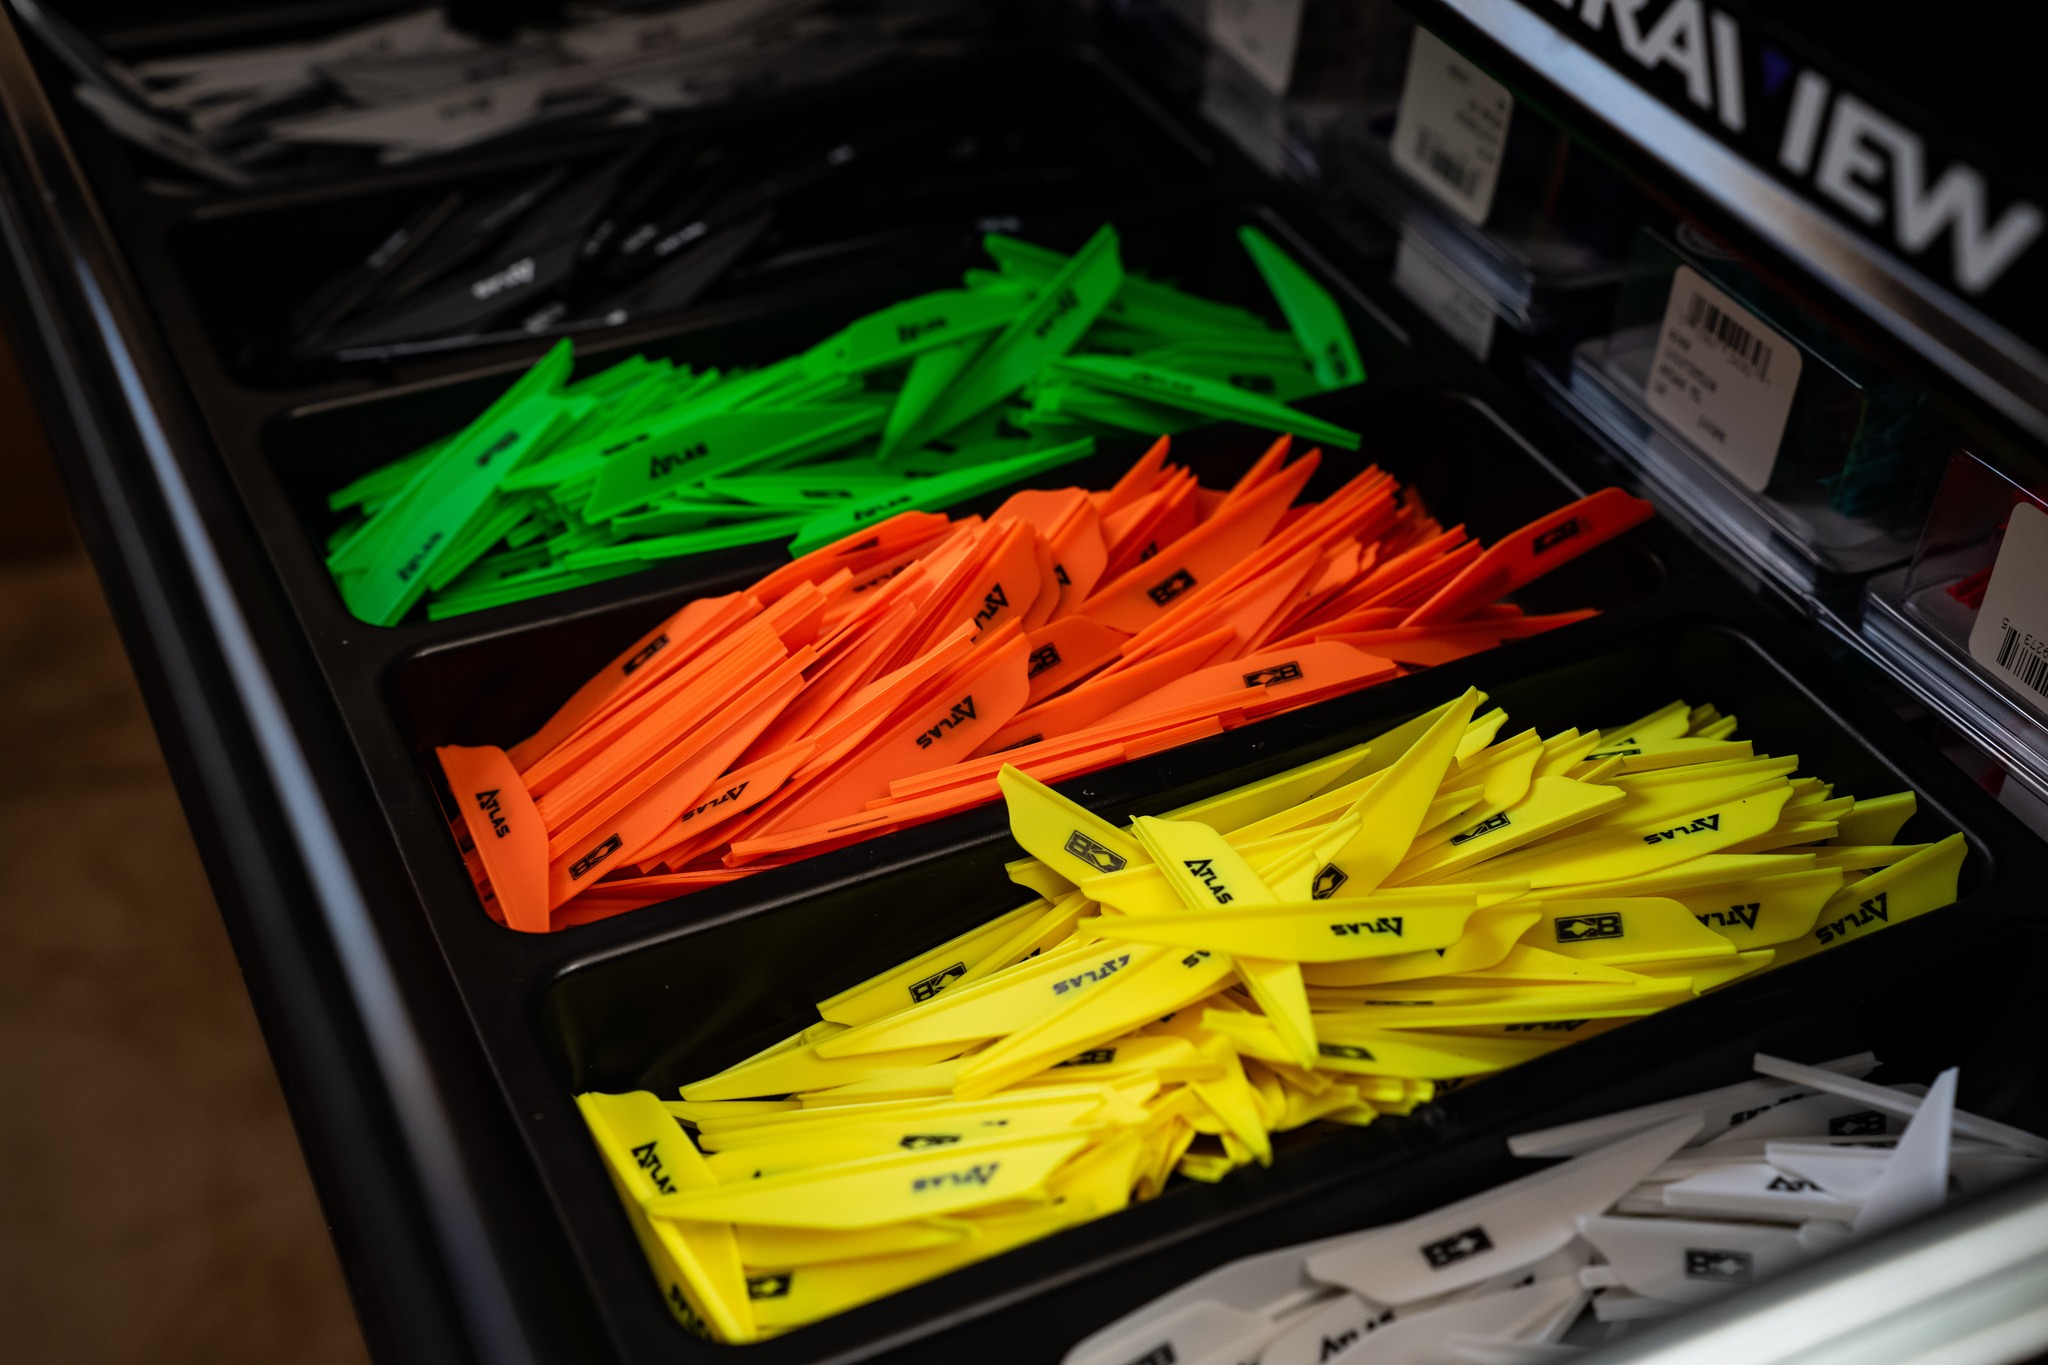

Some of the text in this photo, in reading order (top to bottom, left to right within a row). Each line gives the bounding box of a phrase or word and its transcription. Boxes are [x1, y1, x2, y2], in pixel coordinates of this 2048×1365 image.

[1554, 0, 2044, 296] RAVIEW
[972, 582, 1010, 645] ATL
[2000, 617, 2010, 630] 5
[915, 694, 978, 752] ATLAS
[476, 787, 511, 839] ATLAS
[681, 780, 752, 824] ATLAS
[1642, 812, 1721, 846] ATLAS
[1182, 857, 1234, 906] ATLAS
[1329, 916, 1404, 939] ATLAS
[1695, 901, 1762, 930] ATLA
[1814, 889, 1890, 946] ATLAS
[1053, 953, 1132, 996] ATLAS
[912, 1160, 1001, 1194] ATLAS
